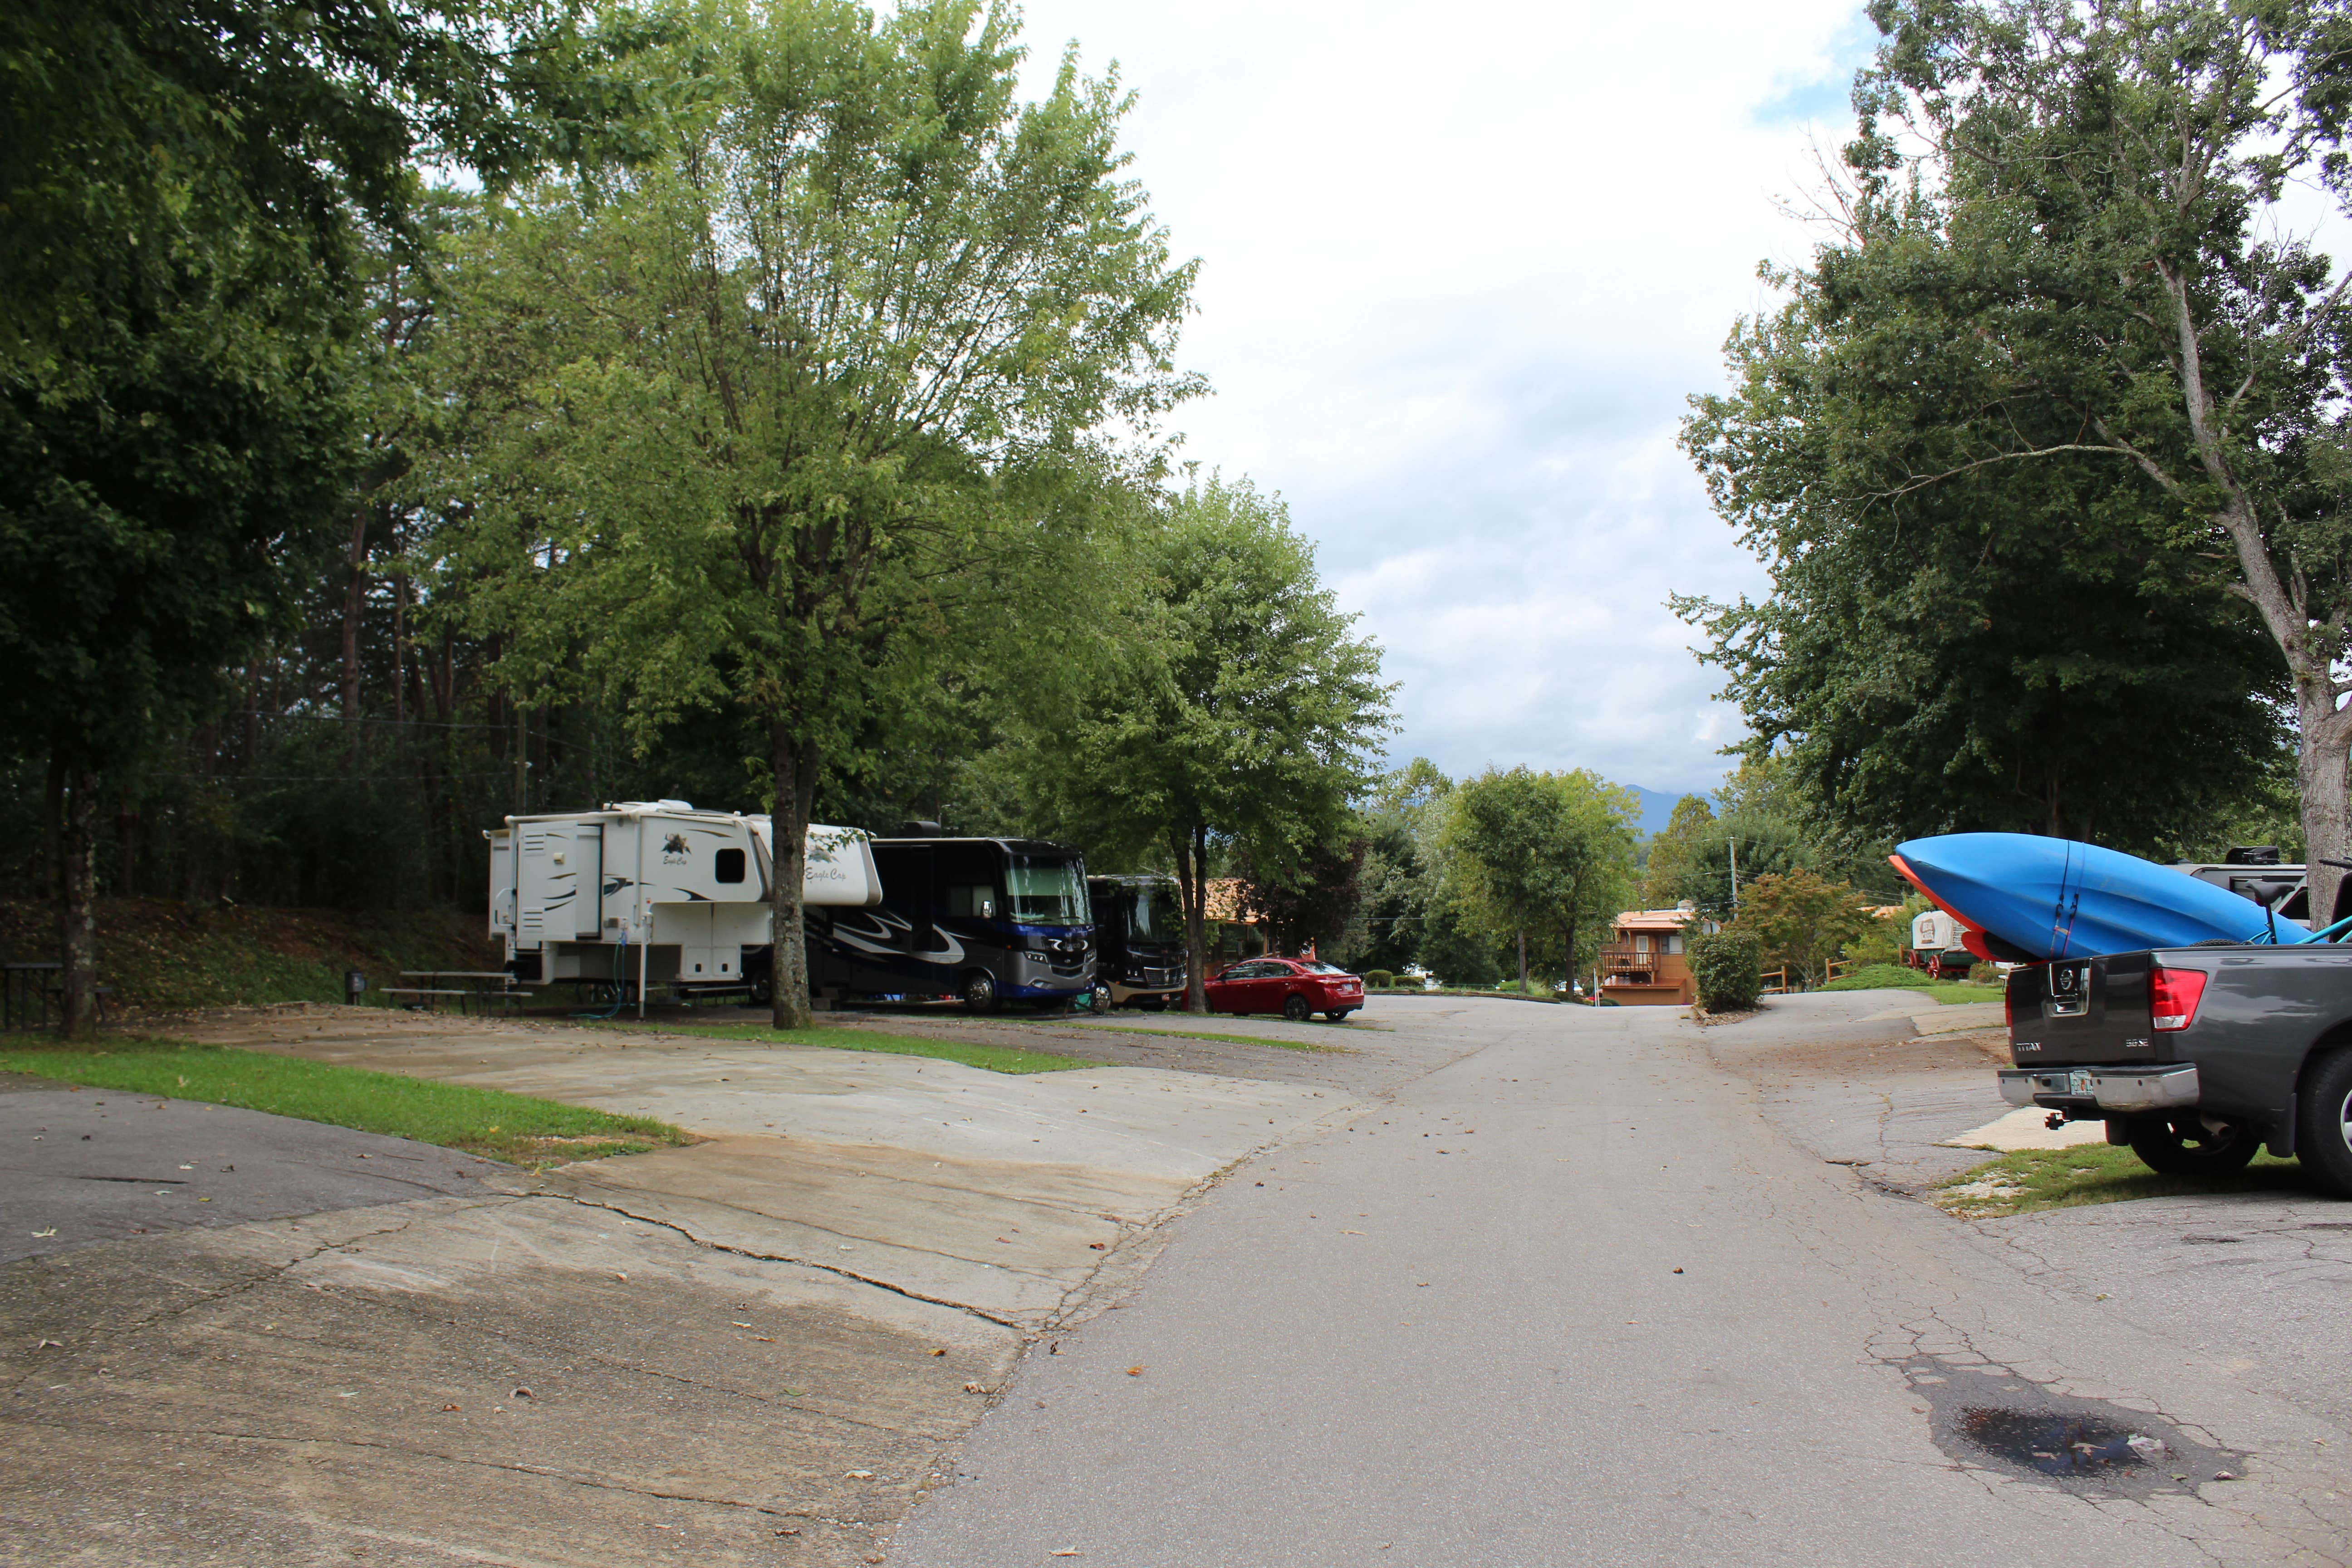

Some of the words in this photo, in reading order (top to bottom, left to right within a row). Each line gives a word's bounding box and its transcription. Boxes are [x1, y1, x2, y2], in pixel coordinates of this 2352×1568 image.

[806, 867, 829, 881] Eagle
[830, 868, 846, 881] Cap
[2016, 1042, 2041, 1052] TITAN
